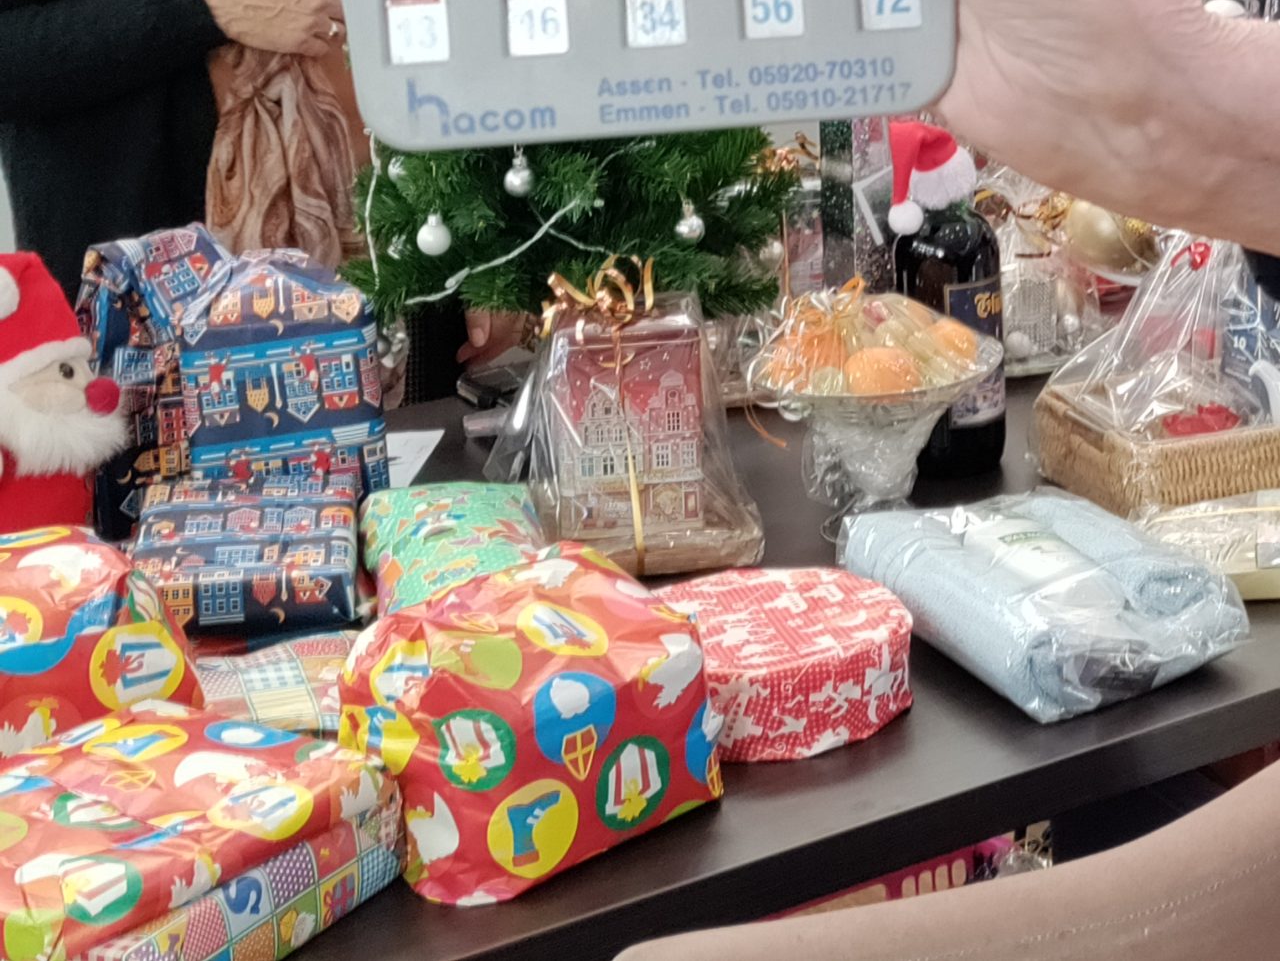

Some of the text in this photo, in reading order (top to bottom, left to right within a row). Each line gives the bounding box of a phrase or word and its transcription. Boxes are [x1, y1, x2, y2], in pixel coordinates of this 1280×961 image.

[518, 5, 560, 39] 16
[637, 0, 680, 33] 34
[598, 77, 672, 97] Assen
[697, 70, 740, 89] Tel.
[748, 57, 895, 86] 05920-70310
[407, 78, 557, 136] hacom
[599, 100, 690, 124] Emmen
[714, 95, 758, 115] Tel.
